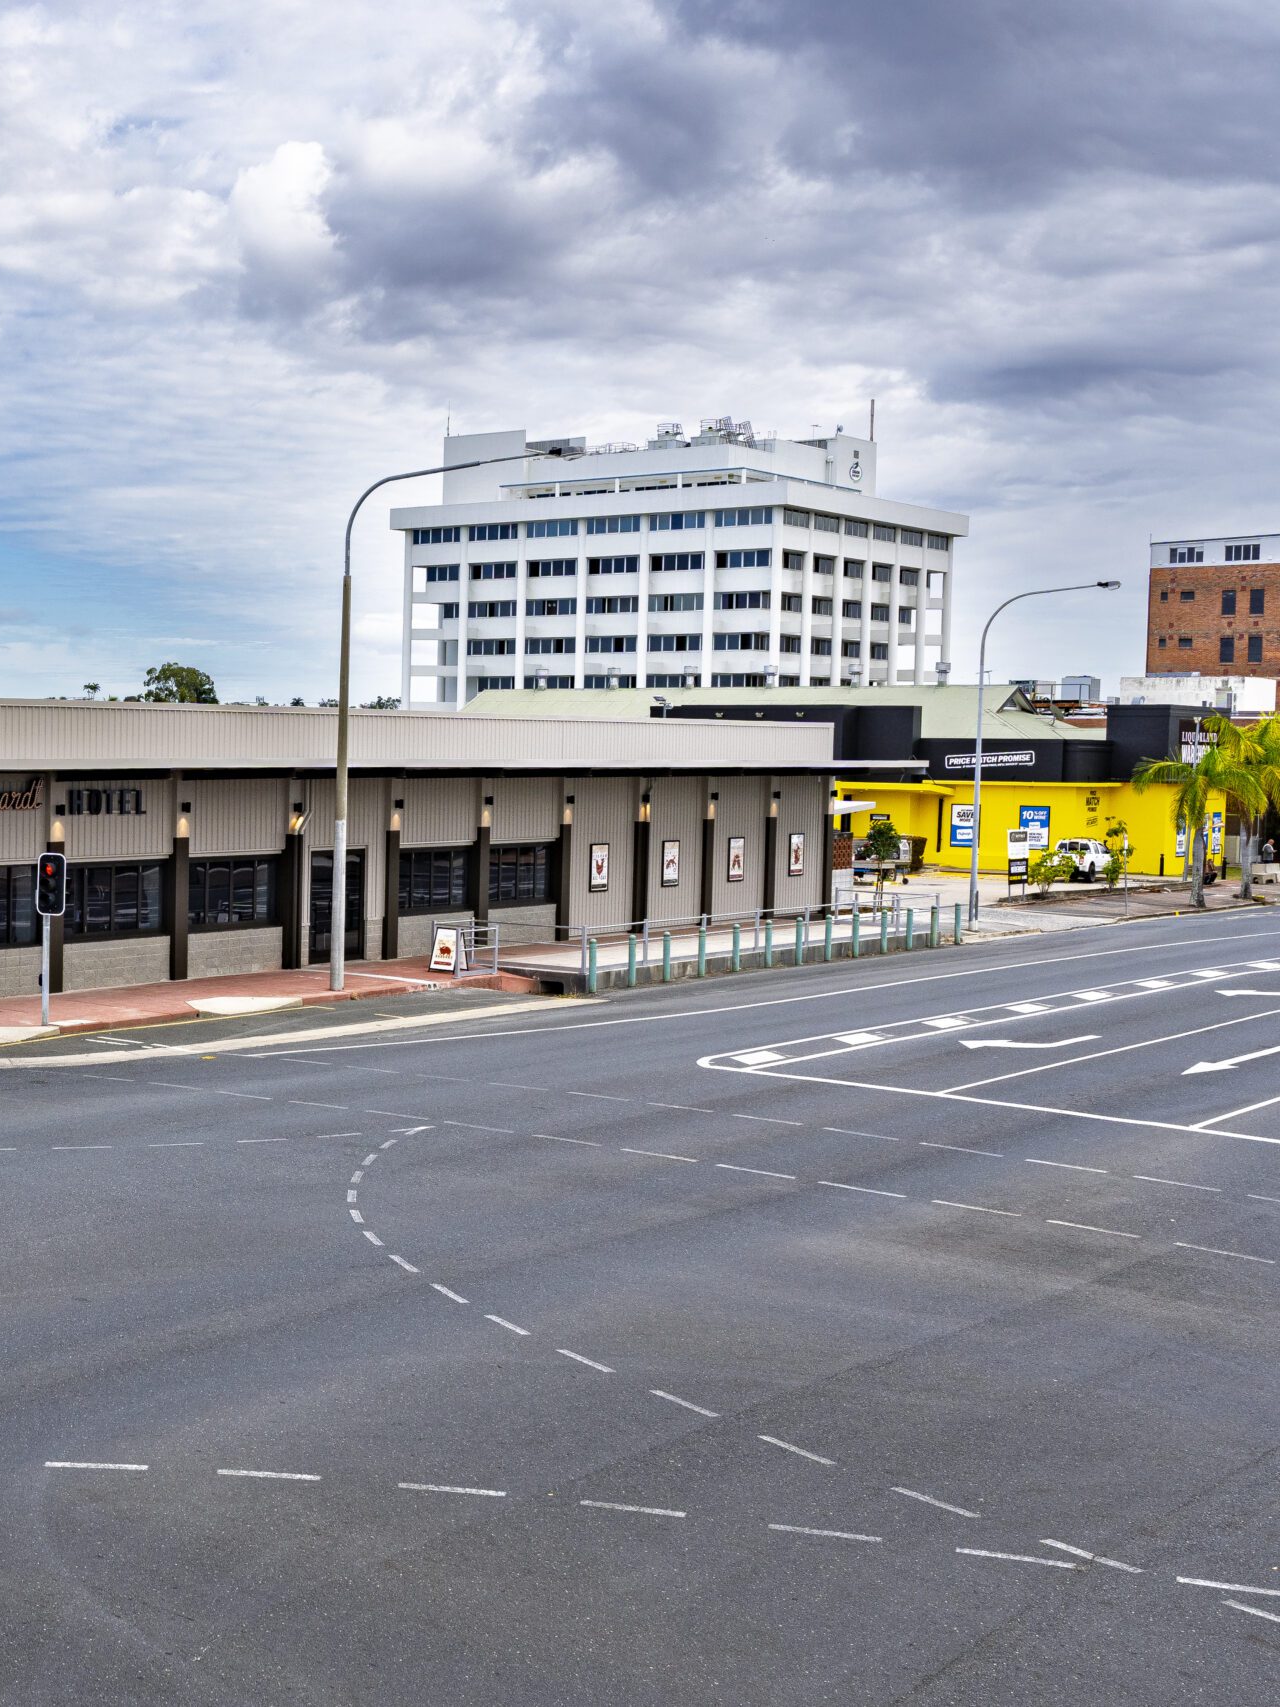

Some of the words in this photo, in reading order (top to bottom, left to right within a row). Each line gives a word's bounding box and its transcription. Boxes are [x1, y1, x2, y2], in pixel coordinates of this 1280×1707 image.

[1182, 731, 1217, 744] LIQURLAD
[971, 756, 997, 764] MTCH
[998, 754, 1031, 762] PROMISE
[69, 789, 146, 815] HOTEL
[1022, 811, 1034, 819] 10
